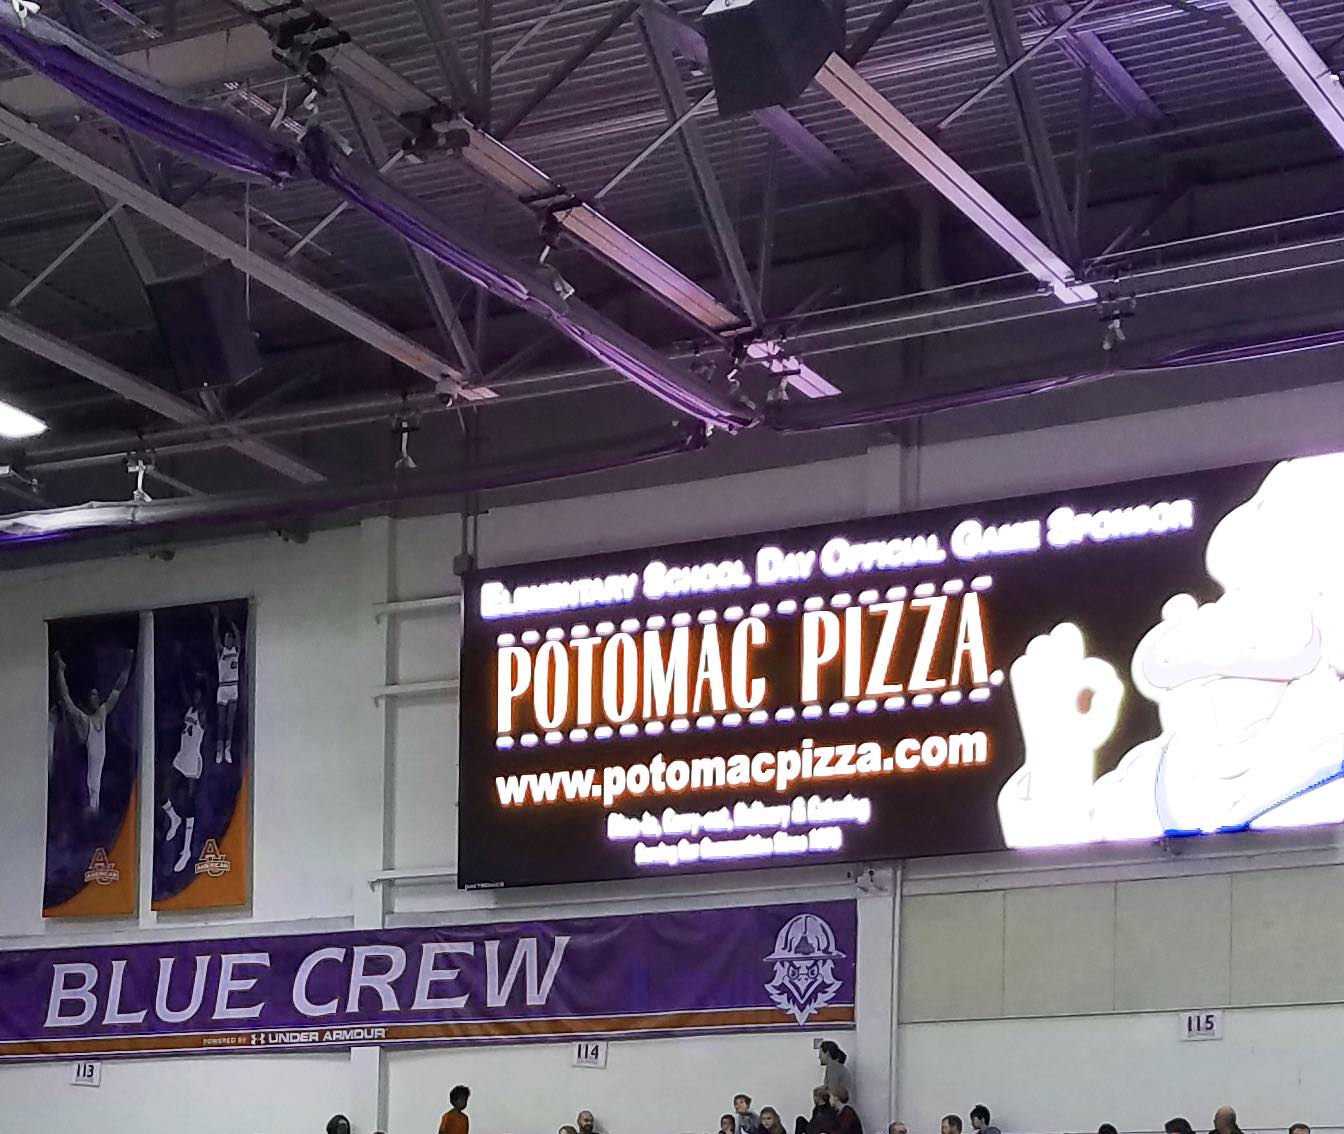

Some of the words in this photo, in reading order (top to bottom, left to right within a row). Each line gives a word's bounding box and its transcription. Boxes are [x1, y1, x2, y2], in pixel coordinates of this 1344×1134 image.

[496, 616, 769, 734] POTOMAC
[496, 731, 988, 807] www.potomacpizza.com
[43, 952, 271, 1028] BLUE
[292, 935, 571, 1017] CREW
[1188, 1015, 1215, 1031] 115
[269, 1032, 319, 1043] UNDER
[322, 1028, 386, 1041] ARMOUR
[578, 1044, 599, 1059] 114
[76, 1064, 94, 1078] 113
